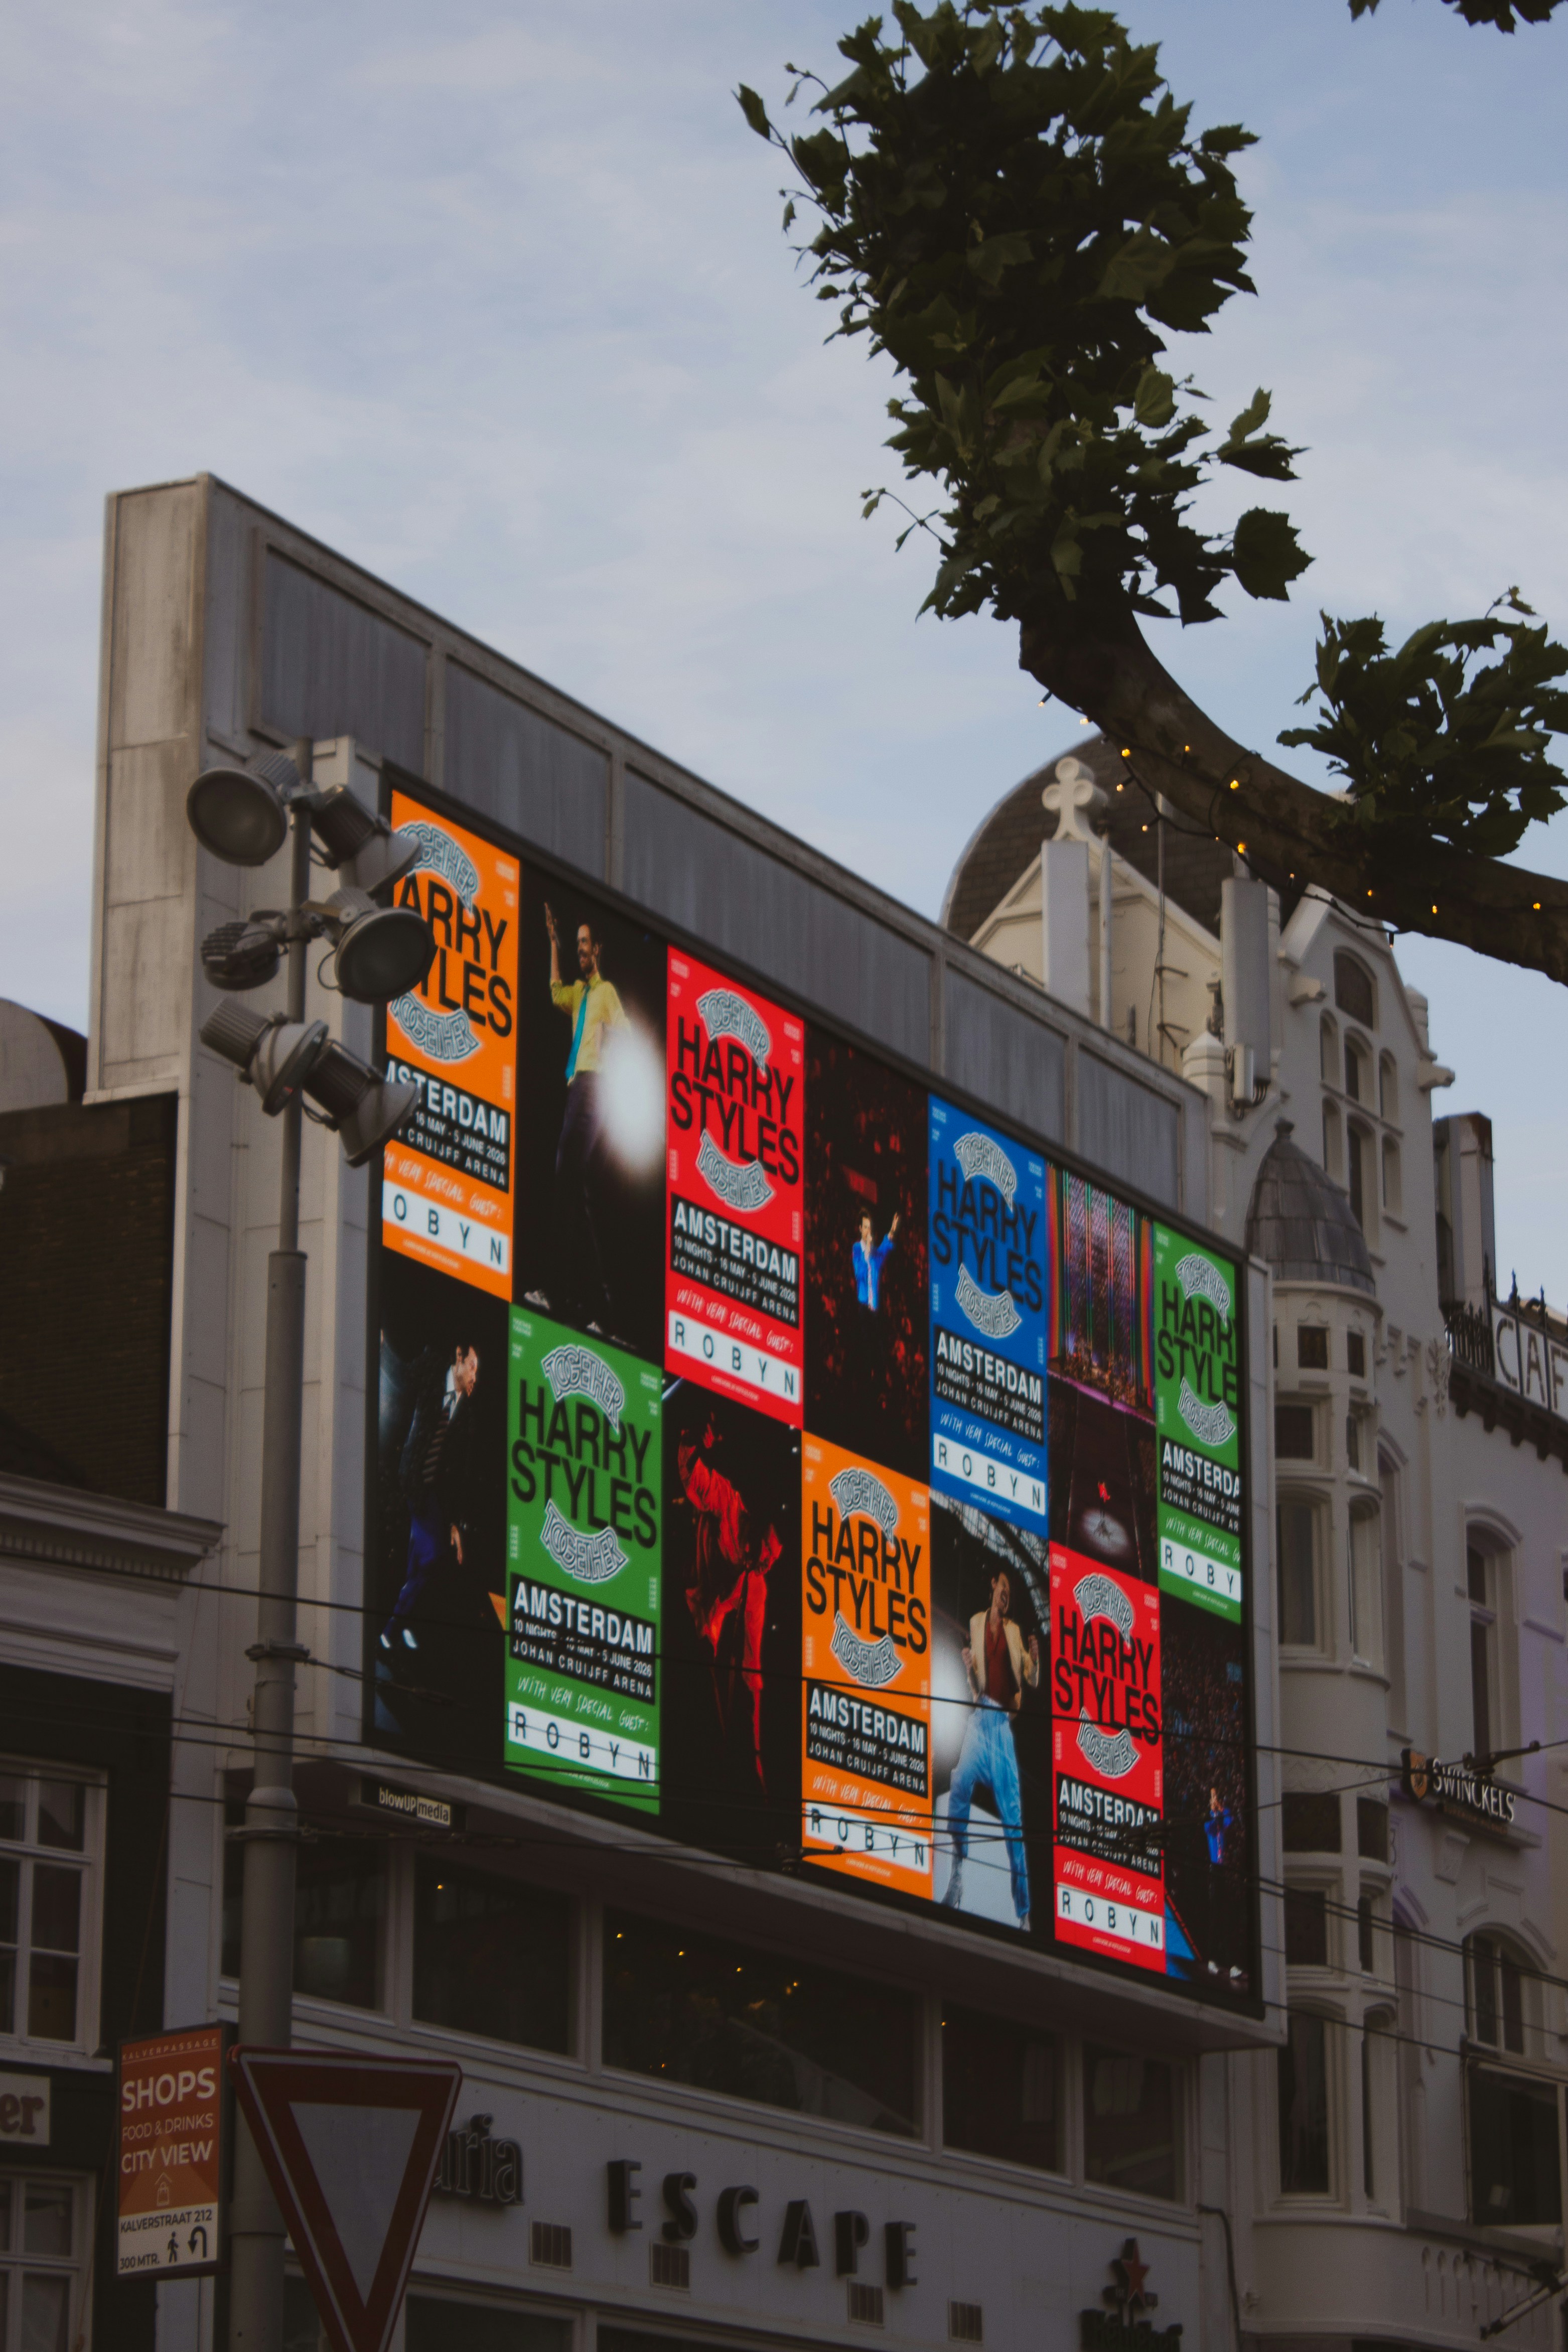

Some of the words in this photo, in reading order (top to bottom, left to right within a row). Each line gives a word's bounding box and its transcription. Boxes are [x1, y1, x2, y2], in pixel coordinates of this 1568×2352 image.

[677, 1015, 795, 1126] HARRY
[406, 1124, 460, 1166] CRUIJFF
[464, 1152, 505, 1187] ARENA
[414, 1108, 423, 1127] 16
[426, 1113, 445, 1138] MAY
[460, 1130, 484, 1156] JUNE
[486, 1142, 506, 1166] 2026
[670, 1067, 800, 1188] STYLES
[423, 1167, 464, 1205] SPECIAL
[938, 1158, 1038, 1257] HARRY
[673, 1198, 796, 1286] AMSTERDAM
[673, 1232, 680, 1250] 10
[683, 1237, 712, 1265] NIGHTS
[720, 1255, 727, 1272] 16
[730, 1260, 745, 1281] MAY
[758, 1273, 778, 1296] JUNE
[779, 1283, 796, 1305] 2026
[932, 1207, 1043, 1315] STYLES
[672, 1252, 708, 1283] JOHAN
[712, 1271, 758, 1306] CRUIJFF
[761, 1293, 796, 1323] ARENA
[728, 1309, 761, 1342] SPECIAL
[675, 1319, 794, 1396] ROBYN
[936, 1330, 1041, 1406] AMSTERDAM
[936, 1362, 943, 1378] 10
[945, 1366, 969, 1390] NIGHTS
[976, 1380, 982, 1396] 16
[984, 1384, 998, 1403] MAY
[1009, 1396, 1026, 1416] JUNE
[1027, 1404, 1041, 1423] 2026
[936, 1379, 966, 1407] JOHAN
[970, 1395, 1009, 1426] CRUIJFF
[1012, 1414, 1041, 1441] ARENA
[519, 1378, 651, 1484] HARRY
[983, 1430, 1012, 1460] SPECIAL
[511, 1435, 656, 1551] STYLES
[939, 1442, 1040, 1508] ROBYN
[1163, 1470, 1169, 1484] 10
[1170, 1473, 1191, 1495] NIGHTS
[1204, 1489, 1216, 1506] MAY
[1163, 1486, 1189, 1510] JOHAN
[1192, 1500, 1225, 1527] CRUIJFF
[811, 1500, 922, 1596] HARRY
[1203, 1532, 1228, 1559] SPECIAL
[514, 1578, 651, 1658] AMSTERDAM
[805, 1553, 927, 1657] STYLES
[513, 1615, 522, 1634] 10
[609, 1648, 631, 1671] JUNE
[633, 1657, 652, 1678] 2026
[513, 1636, 553, 1666] JOHAN
[558, 1651, 609, 1685] CRUIJFF
[613, 1671, 651, 1699] ARENA
[1058, 1605, 1153, 1690] HARRY
[575, 1692, 613, 1724] SPECIAL
[809, 1686, 924, 1756] AMSTERDAM
[1054, 1654, 1159, 1747] STYLES
[515, 1710, 649, 1779] ROBYN
[808, 1740, 842, 1766] JOHAN
[846, 1753, 889, 1782] CRUIJFF
[892, 1769, 924, 1794] ARENA
[809, 1721, 816, 1738] 10
[818, 1724, 845, 1748] NIGHTS
[853, 1736, 860, 1753] 16
[862, 1739, 877, 1758] MAY
[889, 1749, 908, 1769] JUNE
[909, 1756, 925, 1775] 2026
[811, 1808, 923, 1867] ROBYN
[1059, 1809, 1065, 1825] 10
[1067, 1812, 1091, 1834] NIGHTS
[1104, 1872, 1131, 1898] SPECIAL
[1130, 1852, 1158, 1875] ARENA
[1062, 1890, 1158, 1944] ROBYN
[122, 2037, 217, 2060] KALVERPASSAGE
[122, 2067, 216, 2112] SHOPS
[121, 2148, 157, 2174] CITY
[161, 2140, 213, 2167] VIEW
[122, 2122, 151, 2142] FOOD
[155, 2121, 162, 2136] &
[166, 2113, 213, 2134] DRINKS
[120, 2212, 193, 2233] KALVERSTRAAT
[194, 2209, 212, 2222] 212
[607, 2159, 917, 2288] ESCAPE
[120, 2257, 135, 2270] 300
[136, 2253, 160, 2267] MTR.
